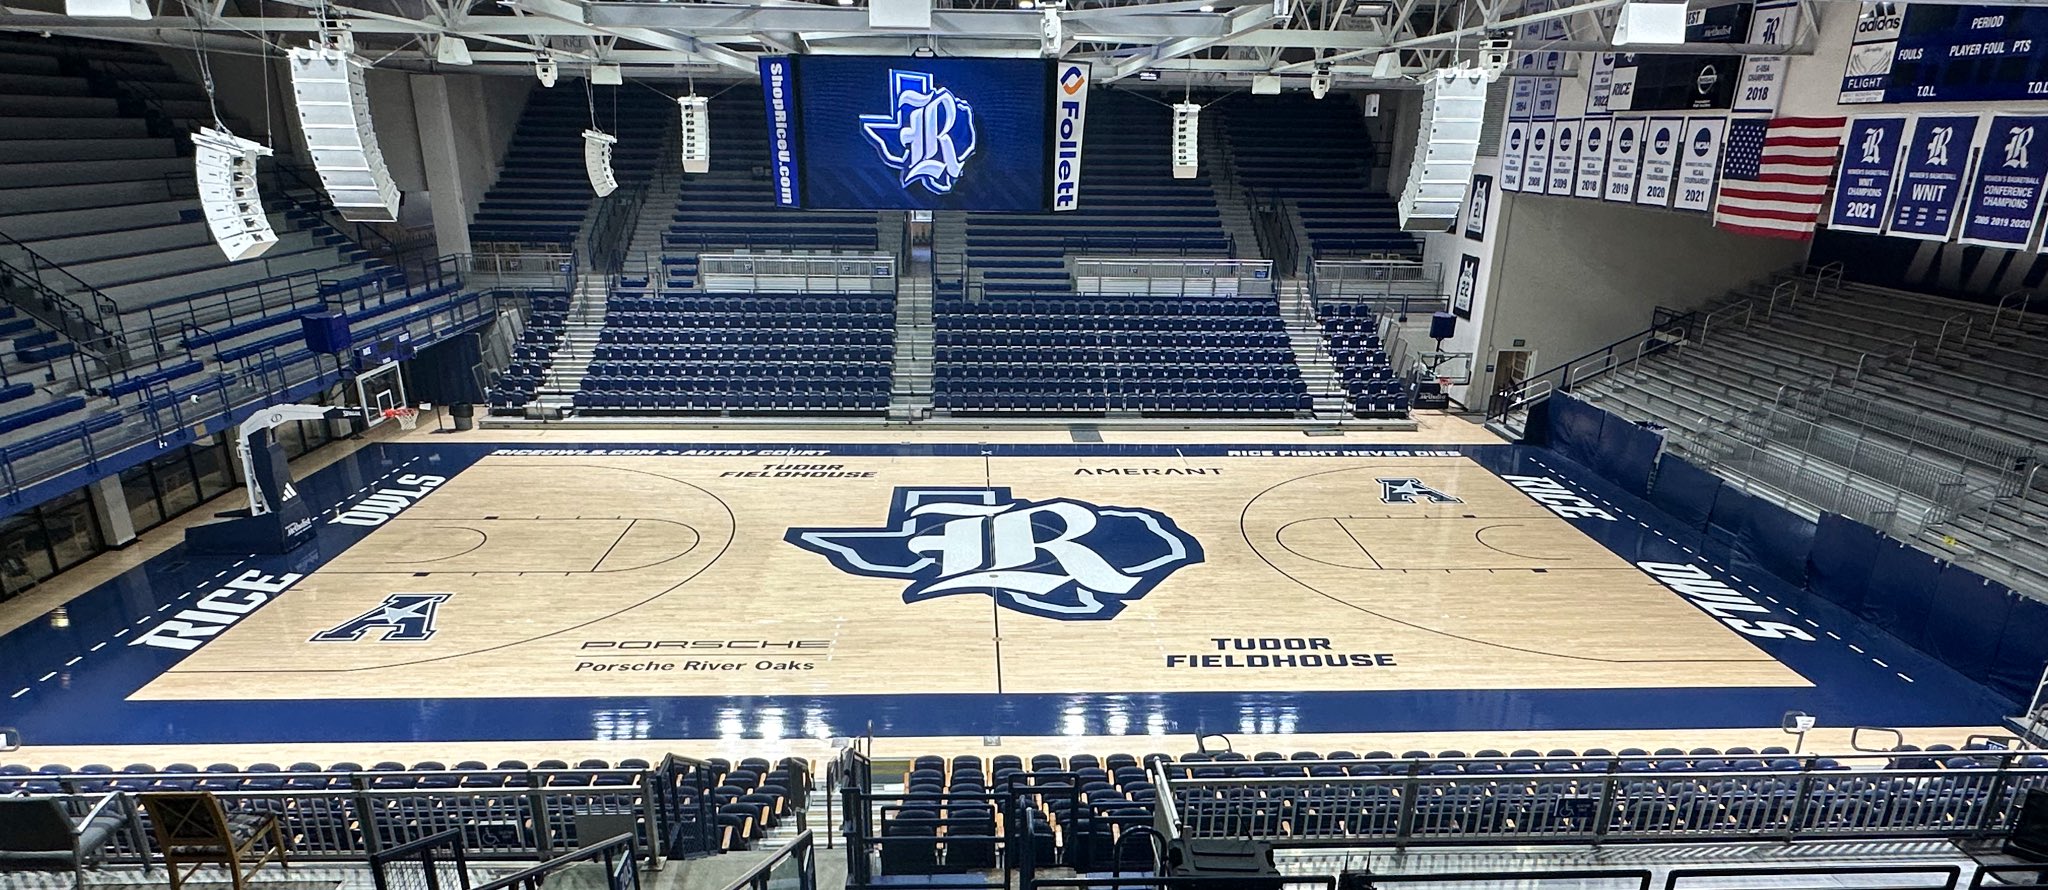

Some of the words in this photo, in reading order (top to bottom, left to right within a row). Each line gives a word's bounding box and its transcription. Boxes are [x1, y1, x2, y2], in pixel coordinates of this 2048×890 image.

[1859, 16, 1900, 33] adidas
[1971, 15, 2004, 29] PERIOD
[1898, 48, 1924, 60] FOULS
[1949, 44, 1981, 57] PLAYER
[1982, 42, 2005, 55] FOUL
[2012, 40, 2032, 53] PTS
[1612, 82, 1632, 96] RICE
[1848, 77, 1882, 88] FLIGHT
[1746, 87, 1769, 100] 2018
[770, 62, 793, 205] ShopRiceU.com
[1056, 101, 1080, 208] Follett
[1581, 180, 1597, 191] 2018
[1984, 175, 2007, 183] WOMEN'S
[2007, 176, 2039, 184] BASKETBALL
[1612, 183, 1629, 195] 2019
[1647, 186, 1665, 198] 2020
[1847, 187, 1882, 197] CHAMPIONS
[1912, 183, 1947, 202] WNIT
[1984, 185, 2034, 197] CONFERENCE
[1685, 190, 1705, 202] 2021
[1983, 196, 2029, 209] CHAMPIONS
[1846, 202, 1877, 219] 2021
[1990, 217, 2009, 227] 2019
[2010, 219, 2031, 228] 2020
[1460, 280, 1470, 297] 22
[326, 473, 448, 527] OWLS
[1500, 474, 1618, 521] RICE
[1636, 561, 1817, 641] OWLS
[128, 569, 302, 650] RICE
[581, 640, 831, 650] PORSCHE
[1210, 638, 1333, 650] TUDOR
[574, 661, 675, 672] Porsche
[683, 660, 747, 671] River
[755, 660, 815, 671] Oaks
[1166, 653, 1397, 668] FIELDHOUSE
